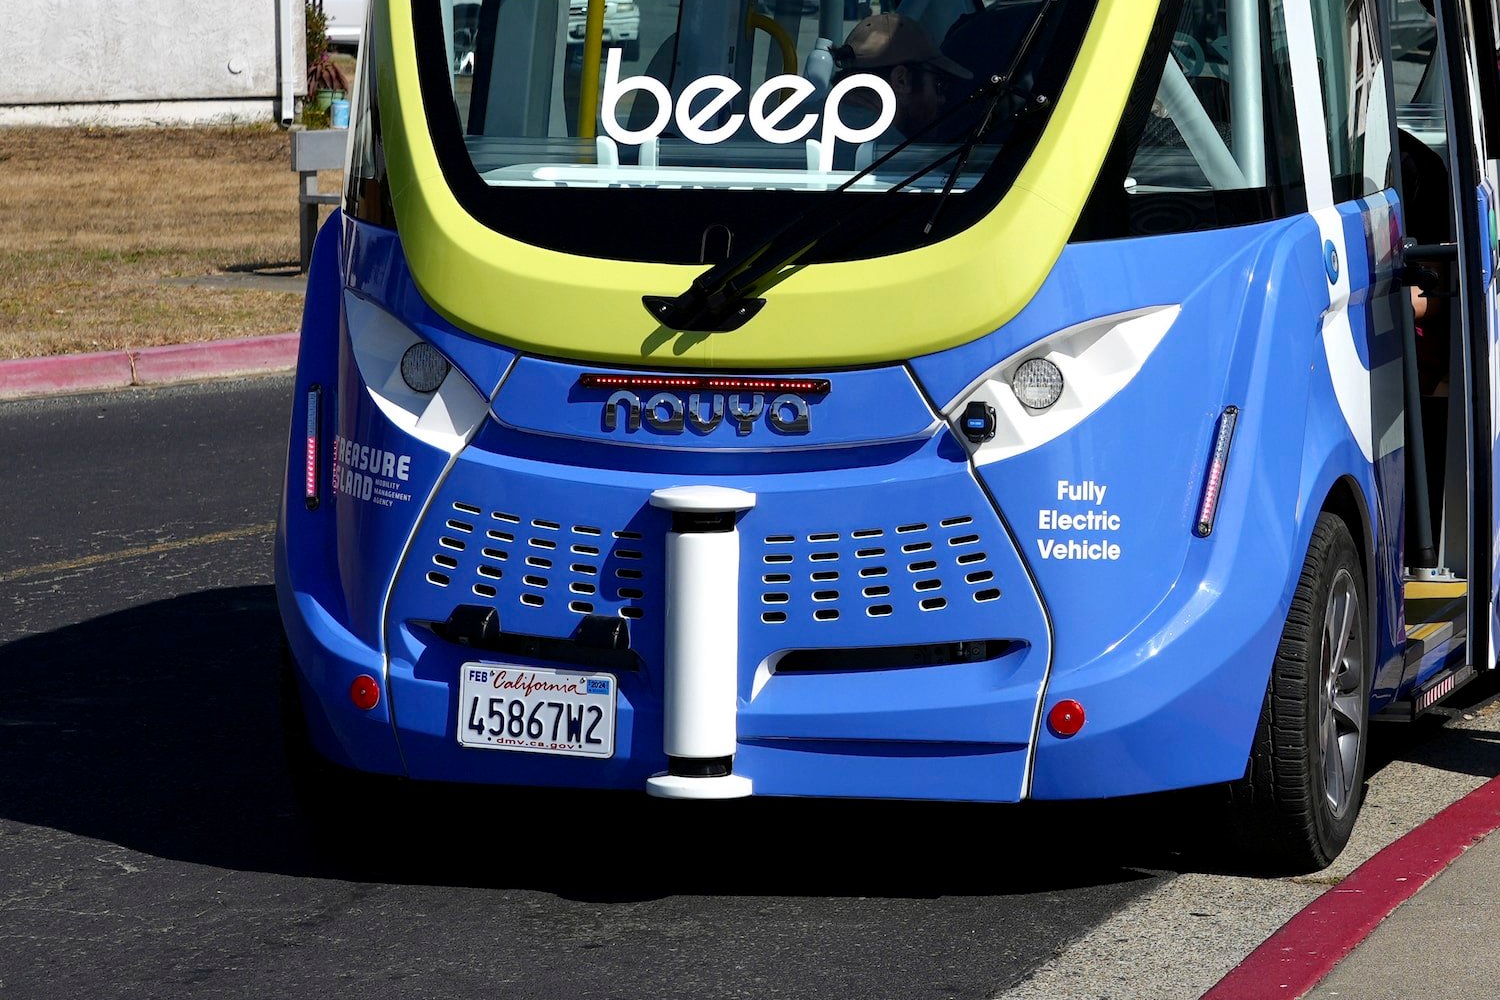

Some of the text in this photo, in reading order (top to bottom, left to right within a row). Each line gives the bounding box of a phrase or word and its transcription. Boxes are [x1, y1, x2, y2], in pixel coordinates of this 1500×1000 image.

[601, 47, 898, 172] beep
[373, 487, 412, 502] MANAGEMENT
[375, 478, 401, 490] MOBILITY
[1057, 480, 1107, 505] Fully
[373, 496, 394, 507] AGENCY
[1038, 508, 1122, 532] Electric
[1037, 538, 1122, 561] Vehicle
[469, 670, 606, 697] FEB California 2024
[468, 696, 604, 745] 45867W2
[496, 737, 575, 750] dmv.ca.gov
